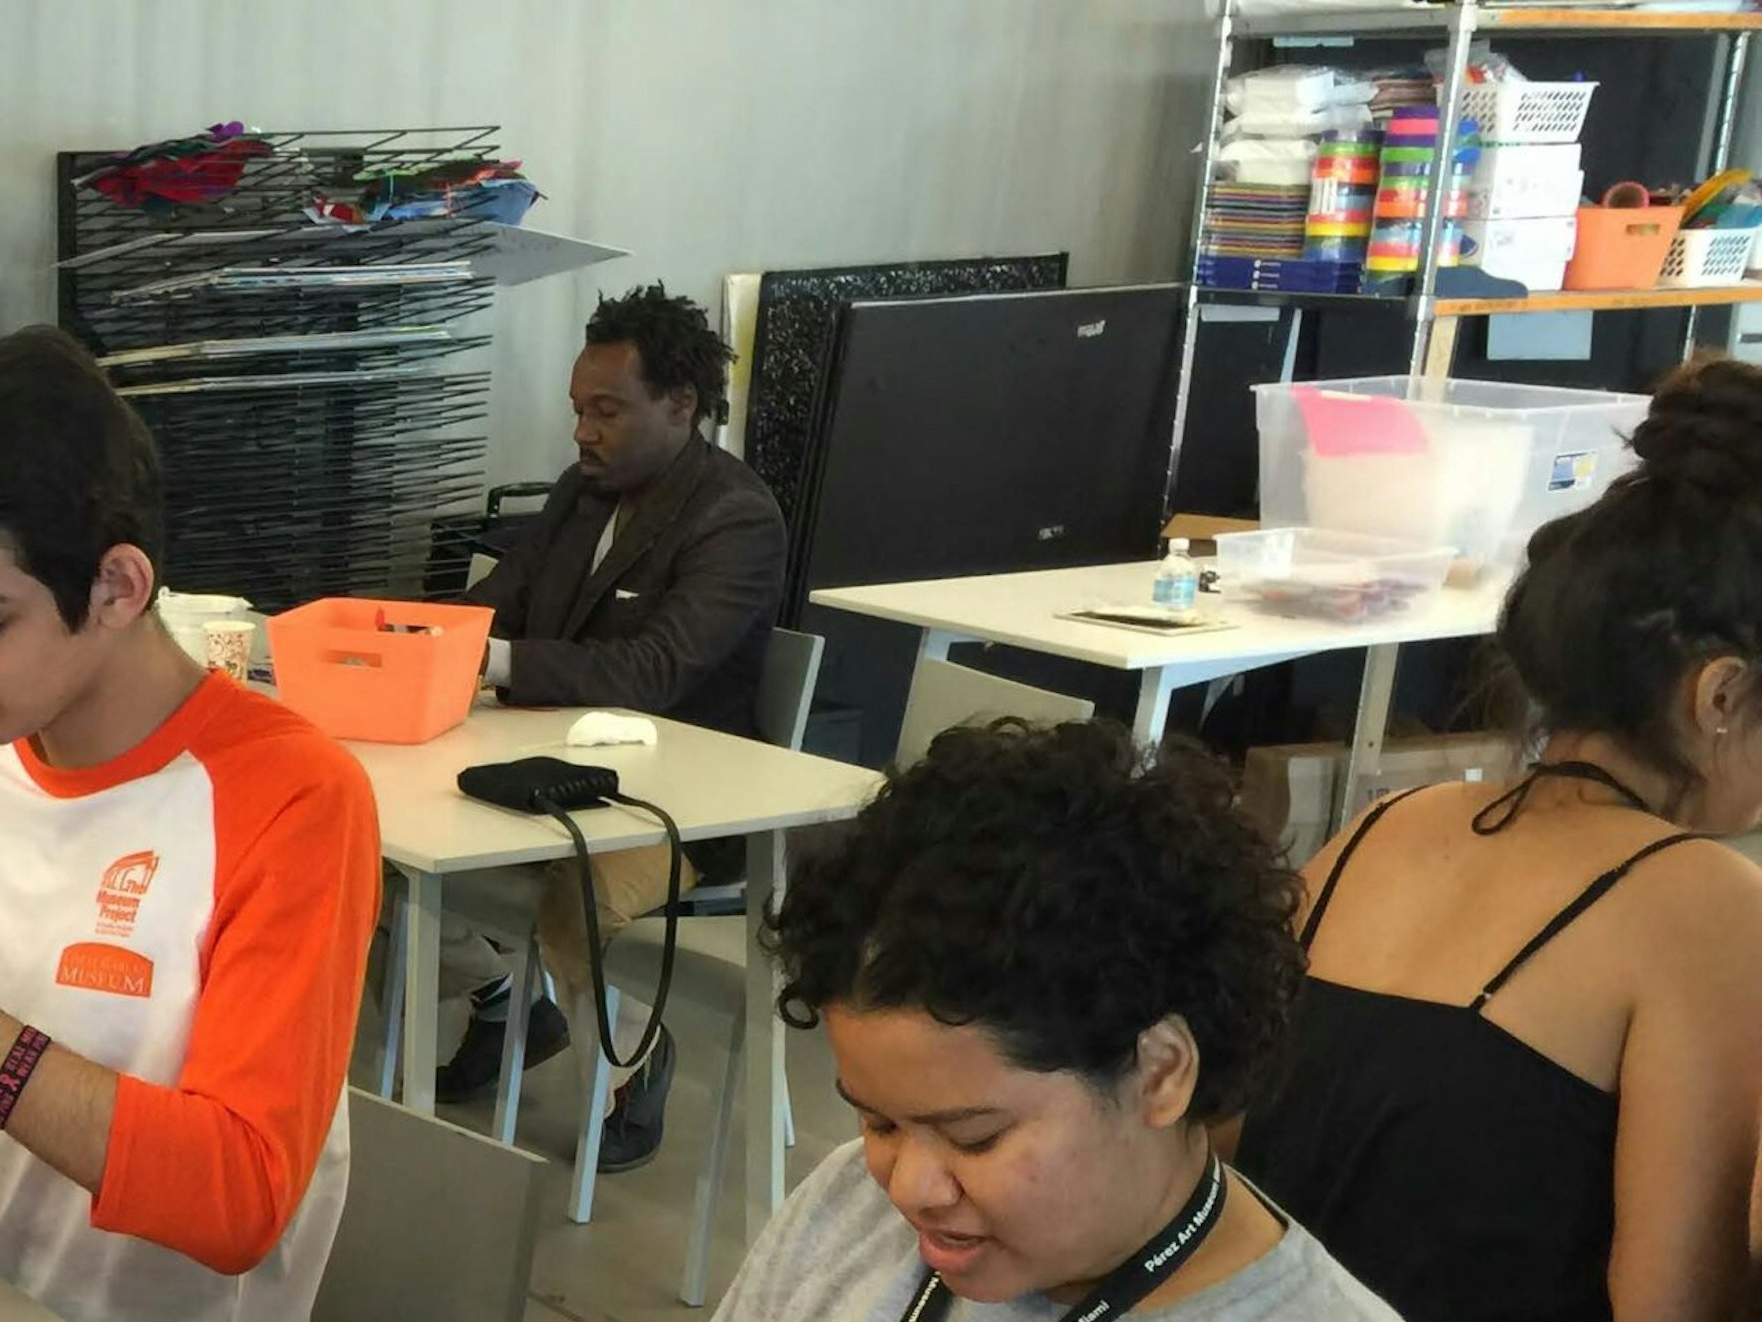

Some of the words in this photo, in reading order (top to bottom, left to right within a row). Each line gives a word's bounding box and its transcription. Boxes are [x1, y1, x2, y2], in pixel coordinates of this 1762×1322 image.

[63, 966, 145, 993] MUSEUM
[1144, 1240, 1179, 1274] Pérez
[1177, 1224, 1198, 1245] Art
